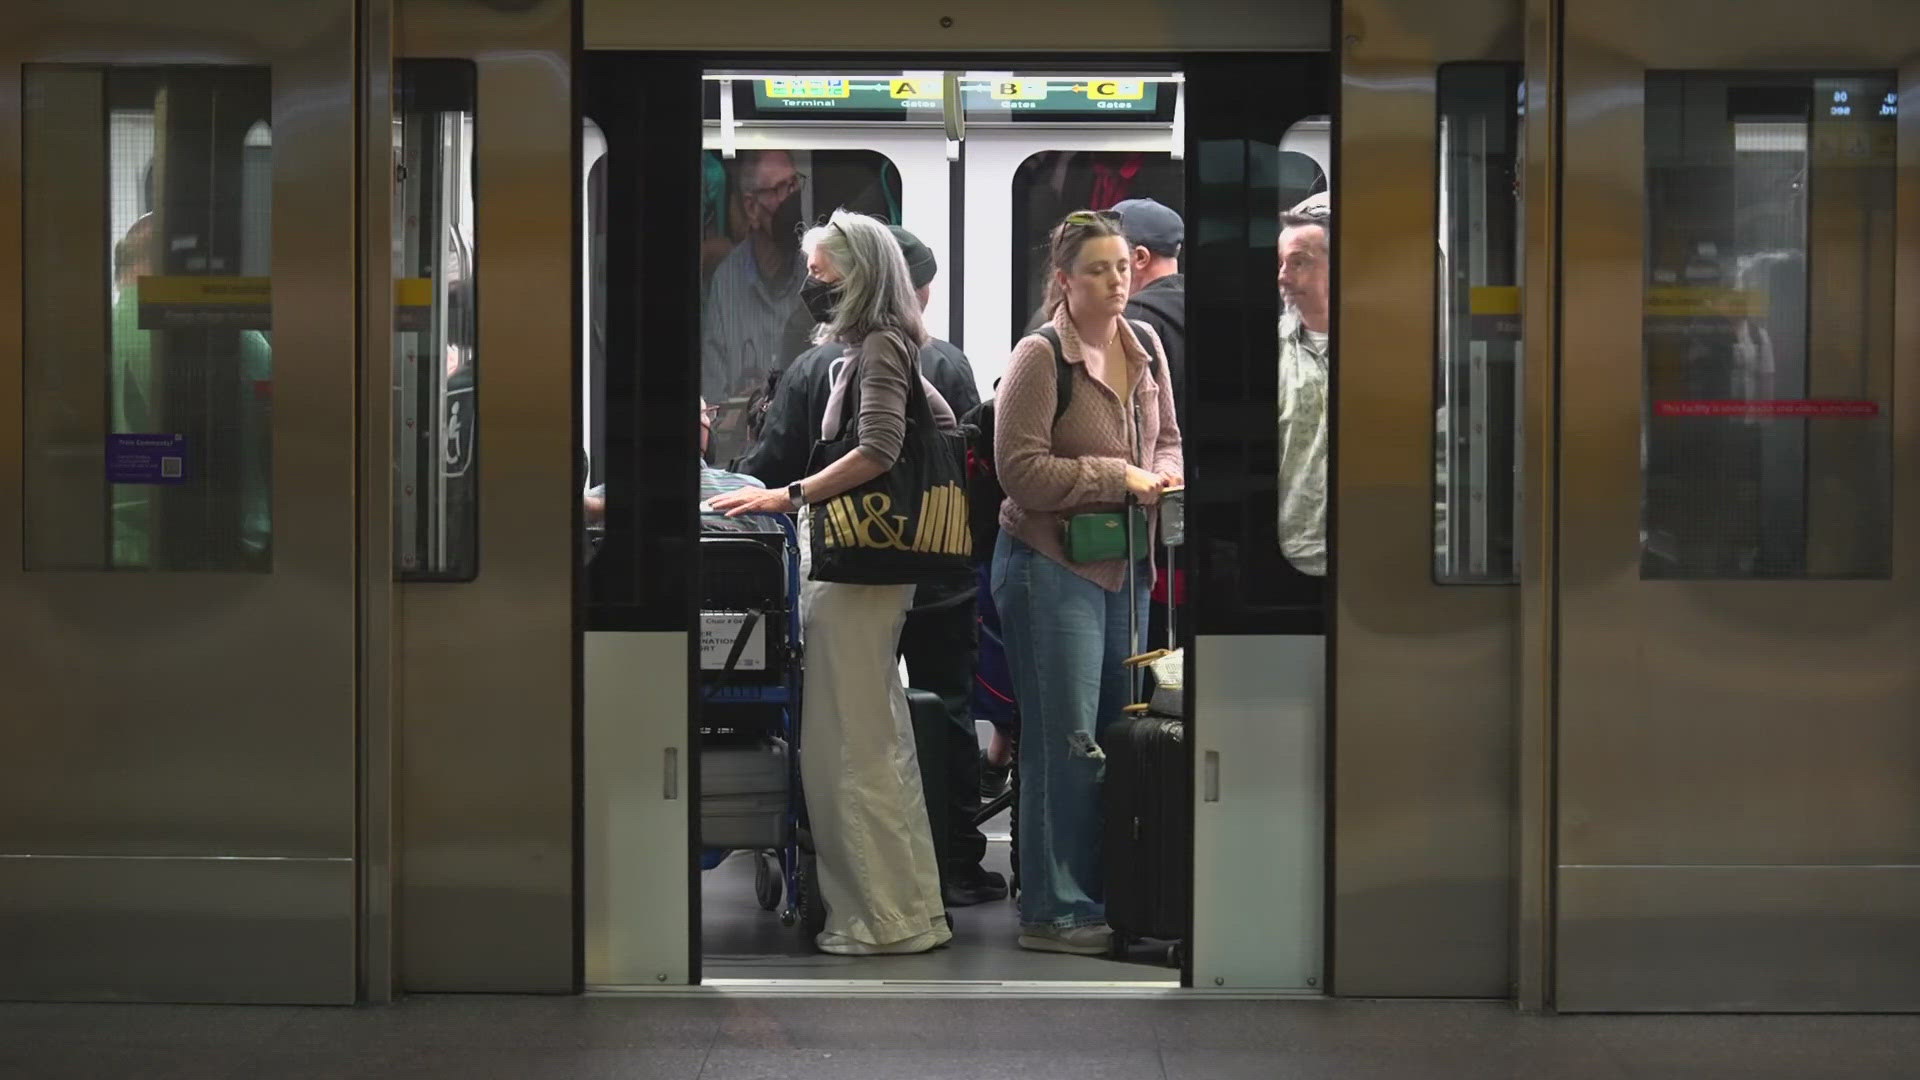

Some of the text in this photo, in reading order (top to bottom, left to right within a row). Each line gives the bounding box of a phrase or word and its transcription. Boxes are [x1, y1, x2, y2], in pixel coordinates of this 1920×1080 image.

[896, 82, 917, 94] A
[999, 83, 1018, 95] B
[1096, 83, 1116, 95] C
[781, 99, 836, 107] Terminal
[901, 100, 937, 108] Gates
[1000, 101, 1037, 109] Gates
[1096, 101, 1133, 109] Gates
